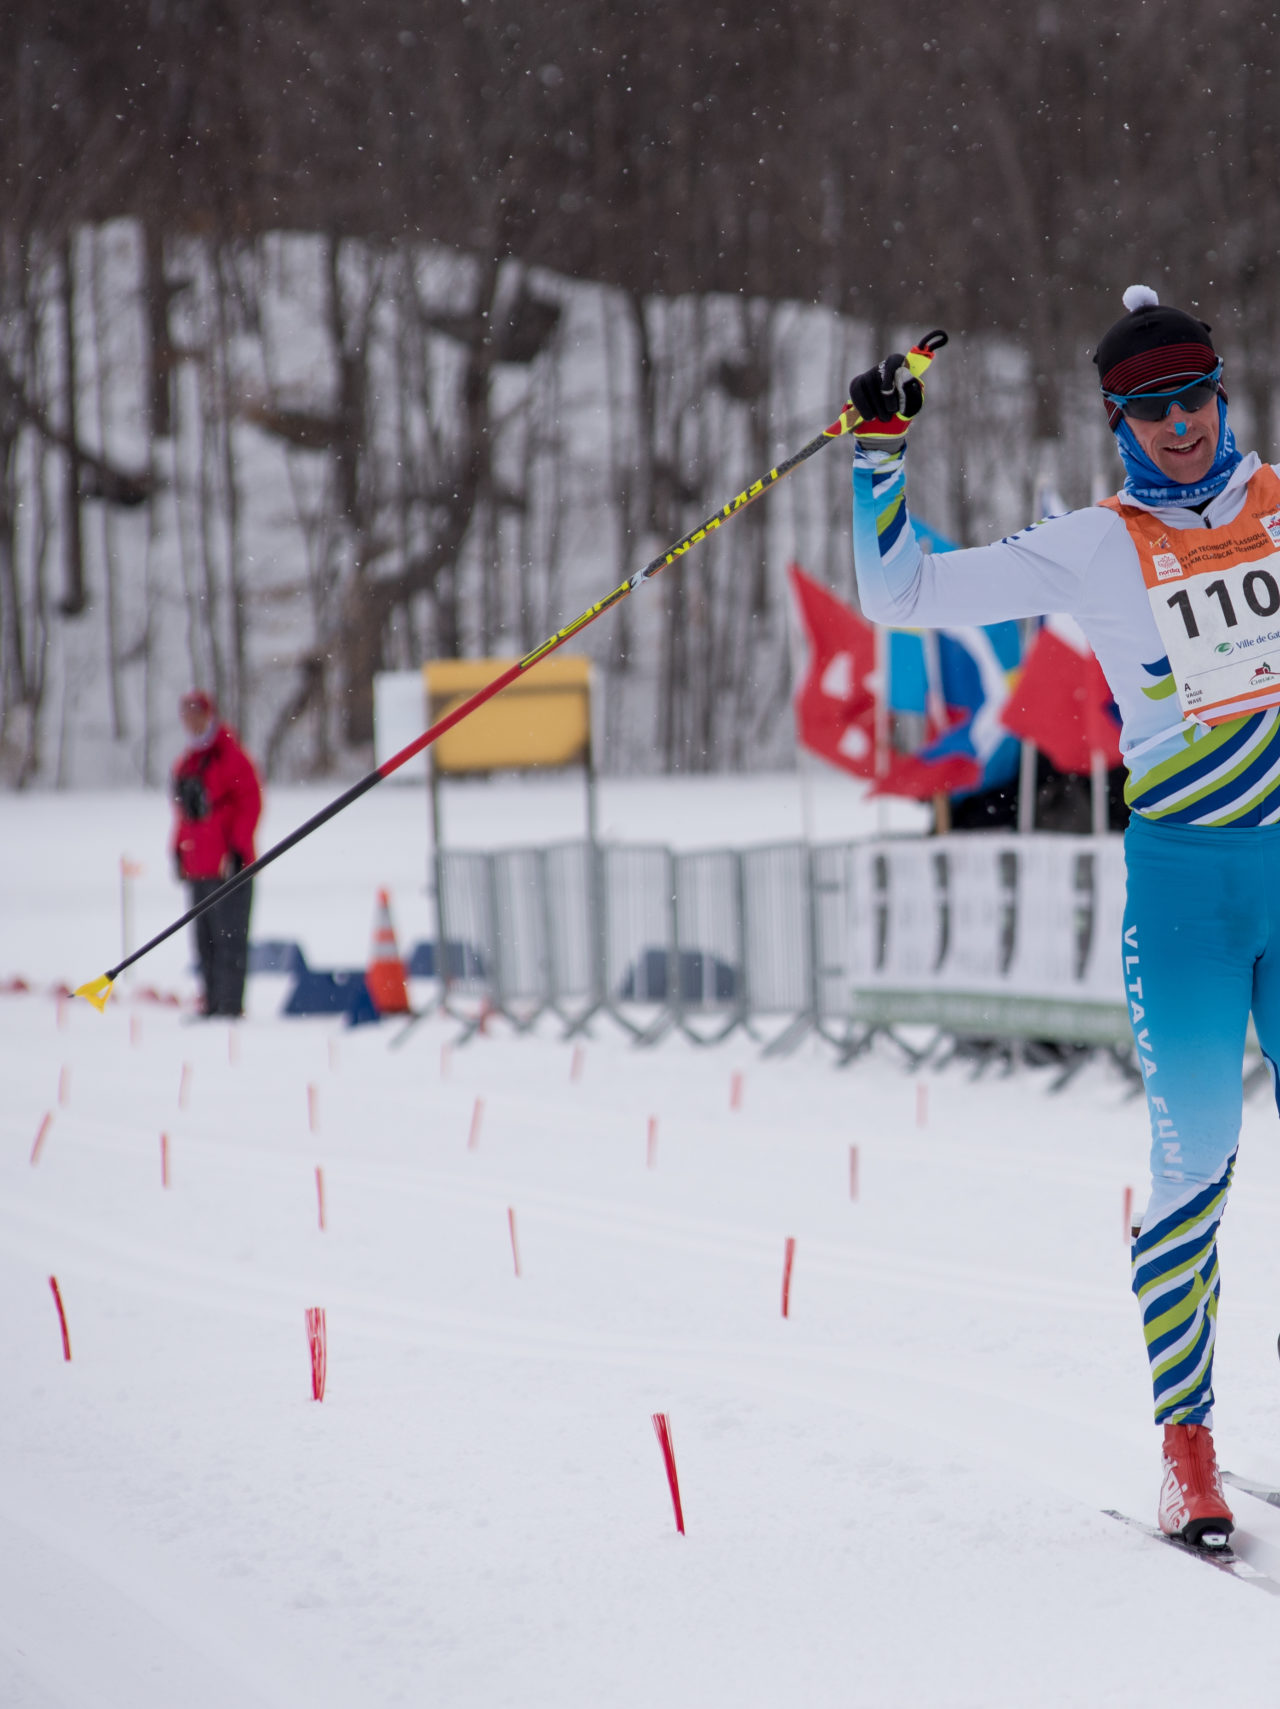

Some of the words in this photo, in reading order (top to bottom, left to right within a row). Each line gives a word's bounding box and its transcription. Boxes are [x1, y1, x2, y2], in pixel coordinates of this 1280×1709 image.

[1236, 639, 1255, 649] Ville
[1256, 634, 1267, 644] de
[1184, 683, 1191, 692] A
[1124, 925, 1158, 1079] VLTAVA
